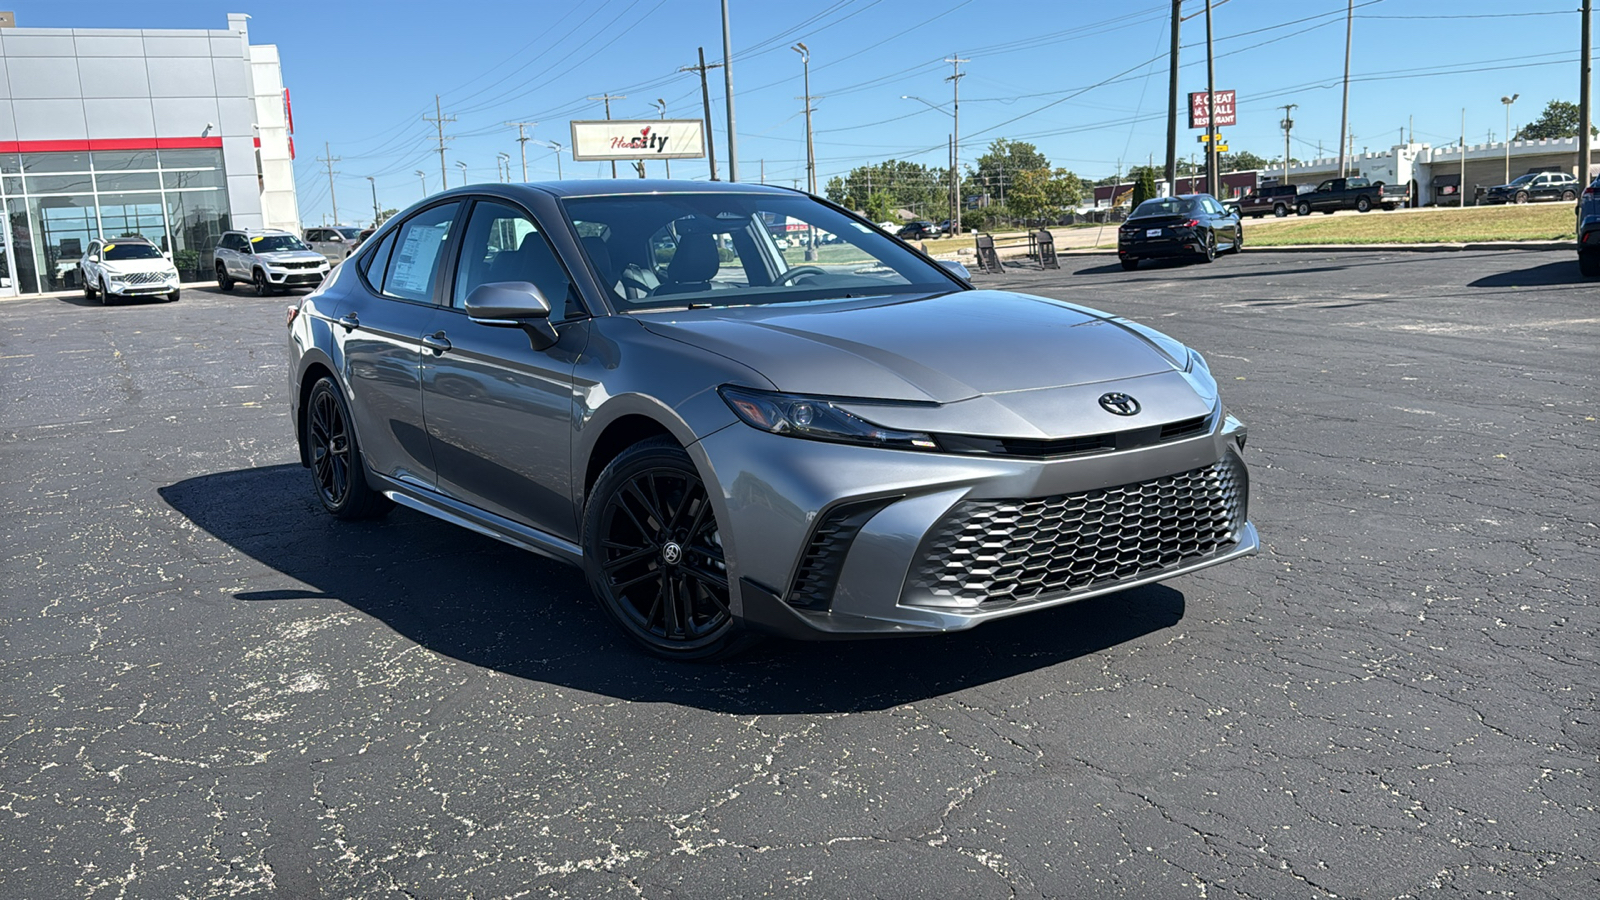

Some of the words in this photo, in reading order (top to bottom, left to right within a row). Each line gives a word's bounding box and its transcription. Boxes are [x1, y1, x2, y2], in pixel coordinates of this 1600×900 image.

[1193, 115, 1234, 125] RESTRANT
[610, 135, 652, 149] Heart
[630, 132, 669, 153] city
